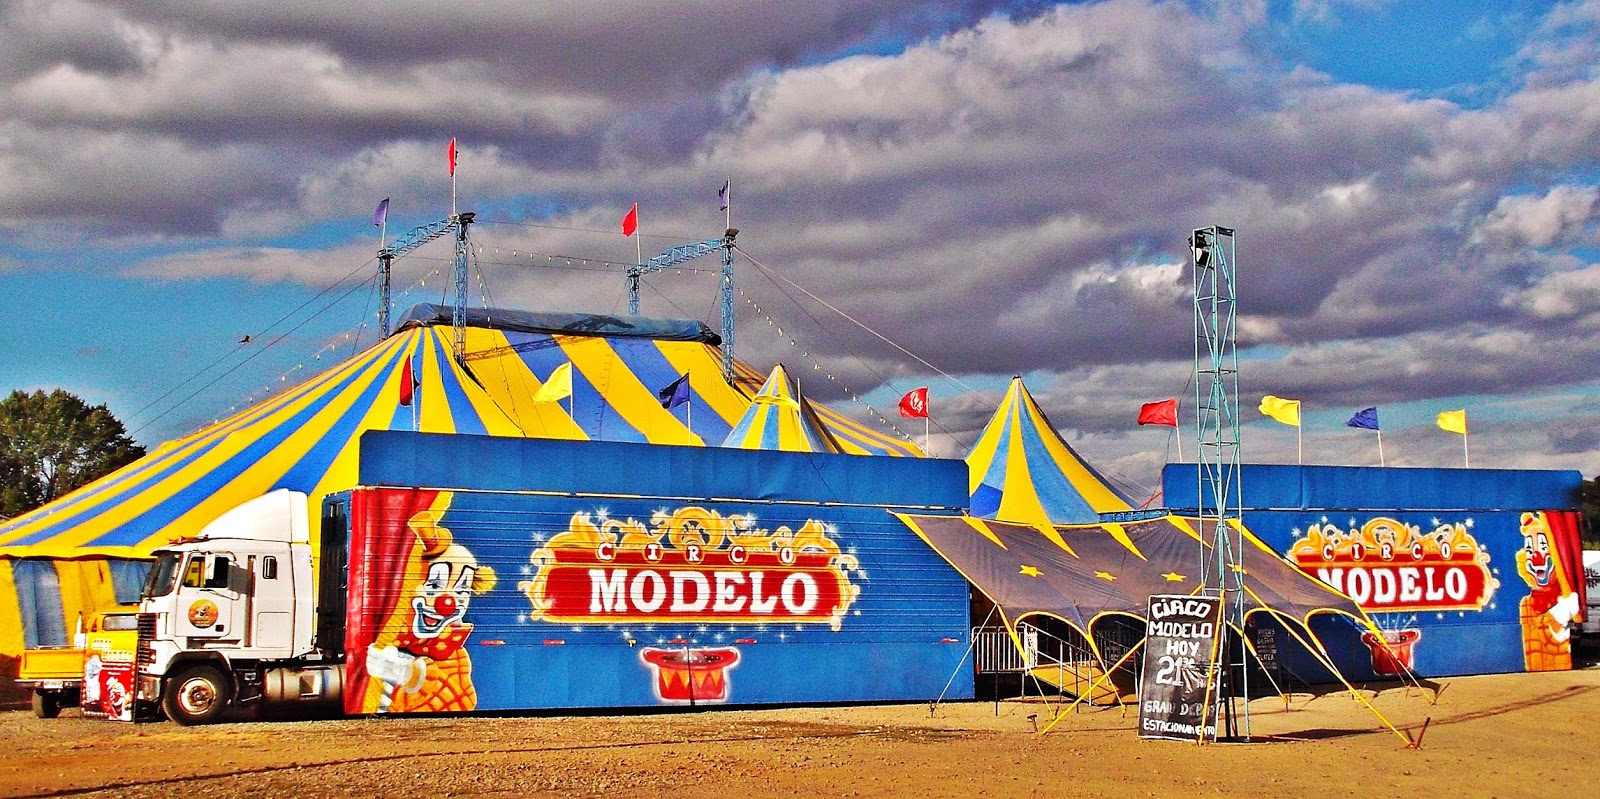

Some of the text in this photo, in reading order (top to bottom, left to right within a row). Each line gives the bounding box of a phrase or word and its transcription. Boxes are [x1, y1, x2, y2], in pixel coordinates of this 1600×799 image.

[597, 544, 794, 564] CIRCO
[1323, 544, 1451, 560] CIRCO
[588, 568, 819, 614] MODELO
[1317, 566, 1468, 604] MODELO
[1149, 621, 1212, 638] MODELO
[1166, 640, 1200, 656] HOY
